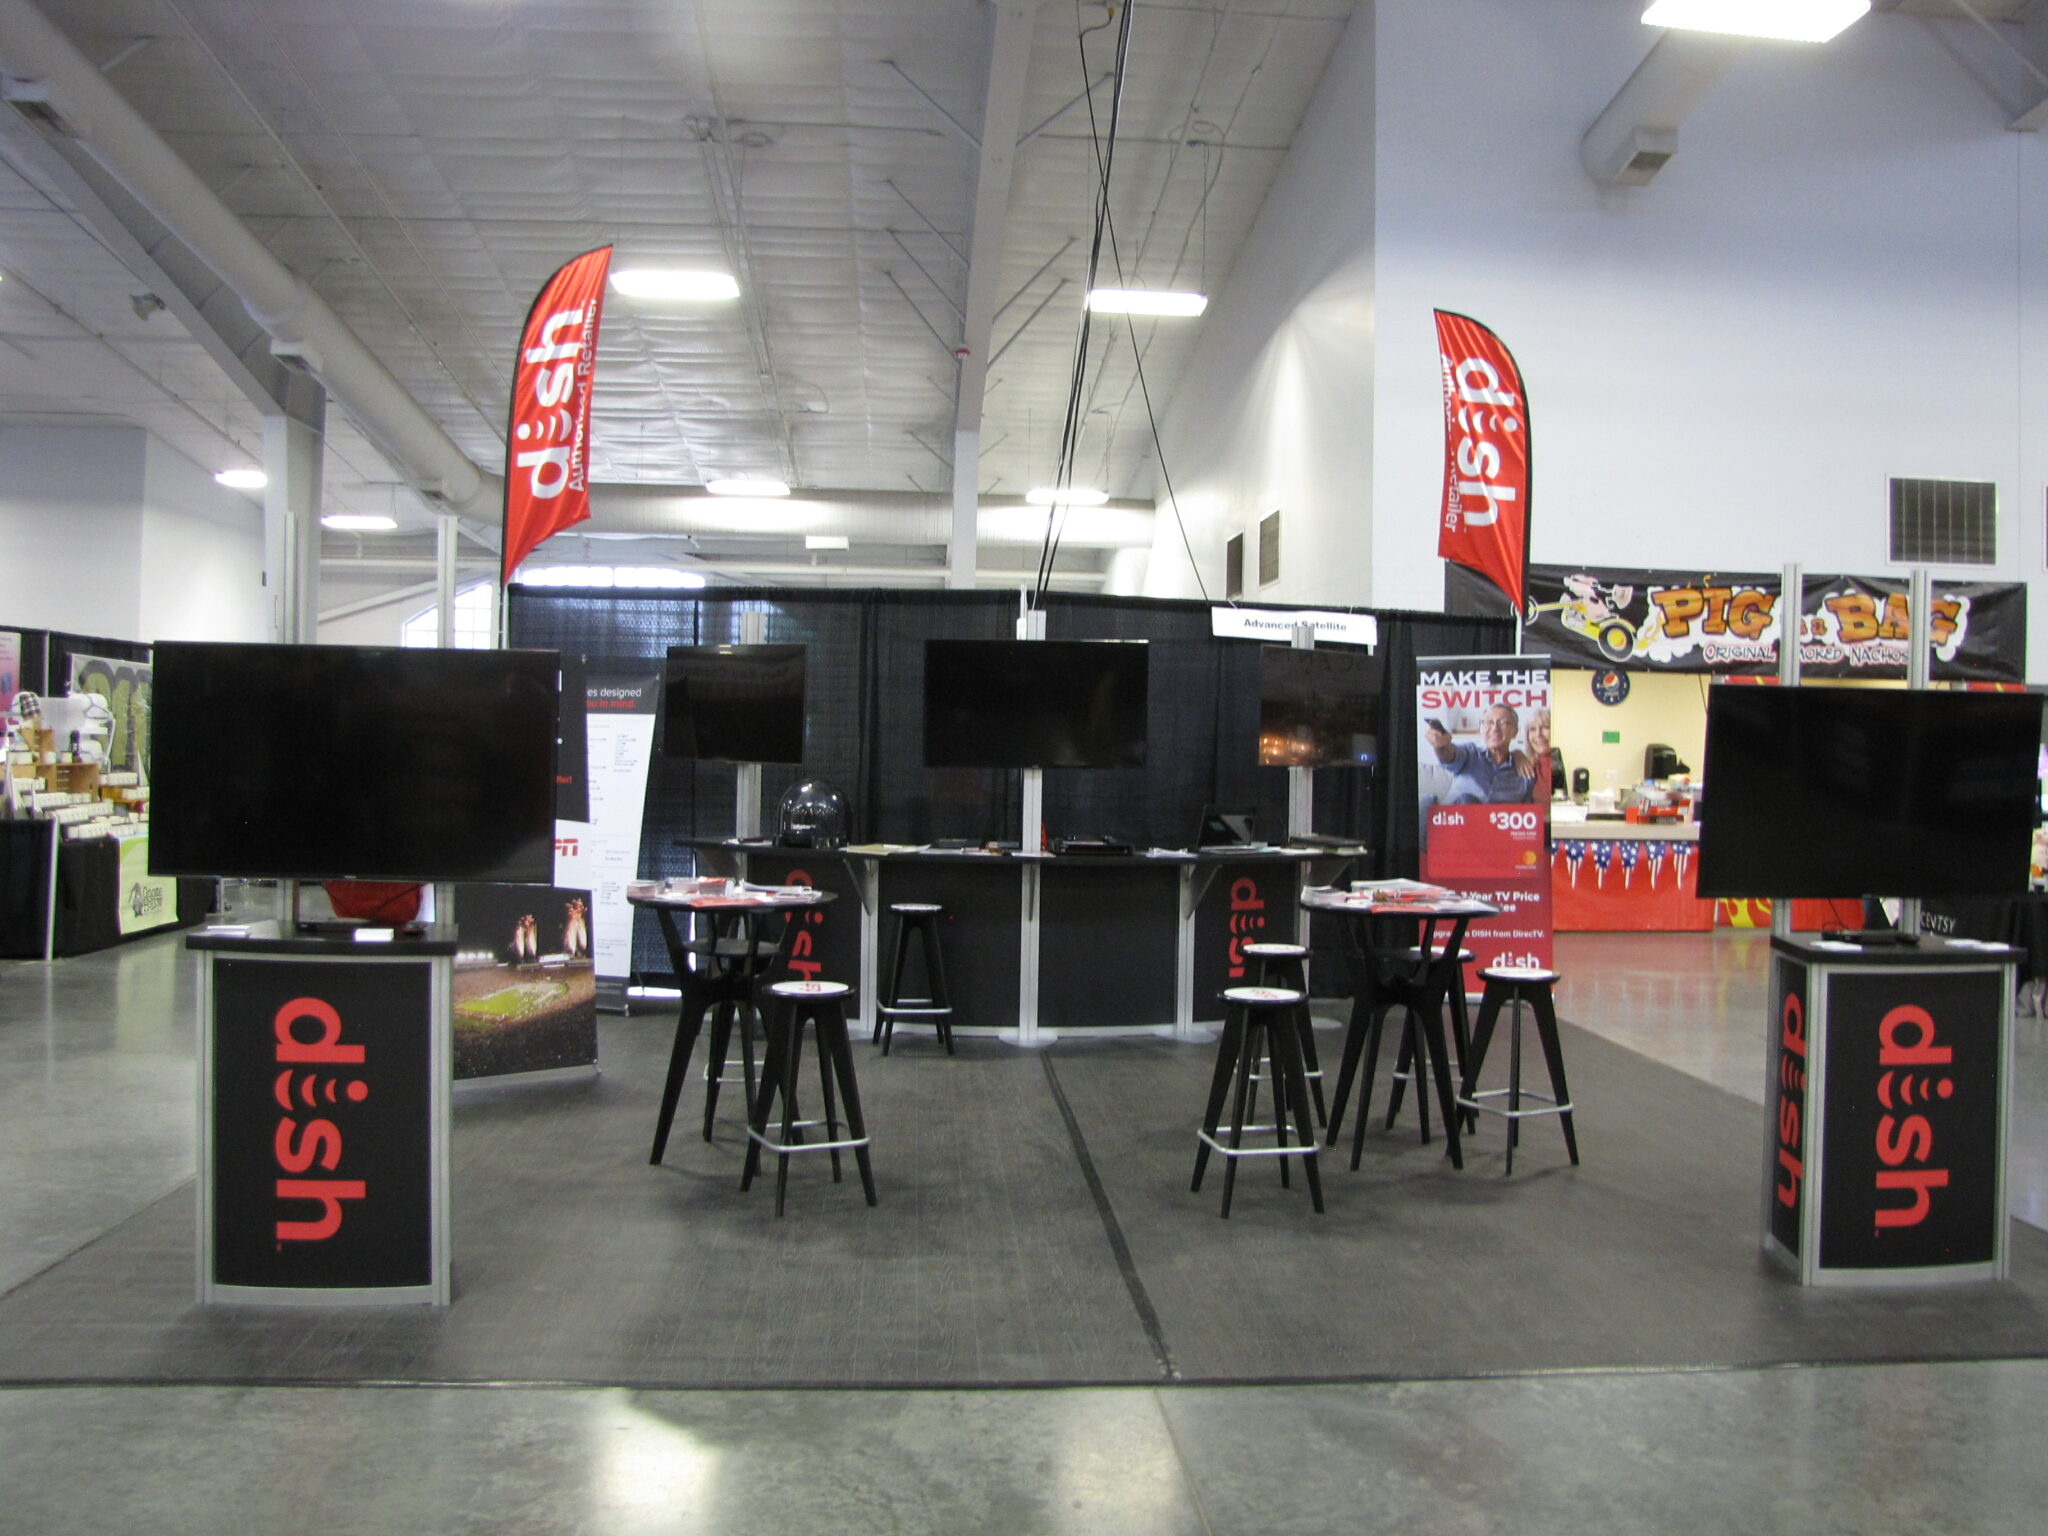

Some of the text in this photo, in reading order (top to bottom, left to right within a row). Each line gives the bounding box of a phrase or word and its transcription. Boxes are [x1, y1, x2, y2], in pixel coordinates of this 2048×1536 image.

[517, 307, 583, 499] dish
[1456, 358, 1518, 526] dish
[1651, 586, 1775, 640] PIG
[1244, 618, 1347, 632] Advanced Satellite
[1799, 646, 1842, 661] OKED
[1851, 645, 1909, 663] NACHOS
[1420, 669, 1547, 687] MAKE THE
[600, 687, 642, 699] designed
[1422, 689, 1547, 709] SWITCH
[1432, 811, 1537, 830] dish $300
[1495, 891, 1511, 901] TV
[1513, 891, 1540, 902] Price
[1228, 877, 1265, 978] dis
[1471, 930, 1491, 938] DISH
[1493, 930, 1512, 938] from
[1492, 951, 1540, 969] dish
[1777, 992, 1807, 1208] dish
[274, 996, 369, 1241] dish
[1874, 1004, 1954, 1228] dish
